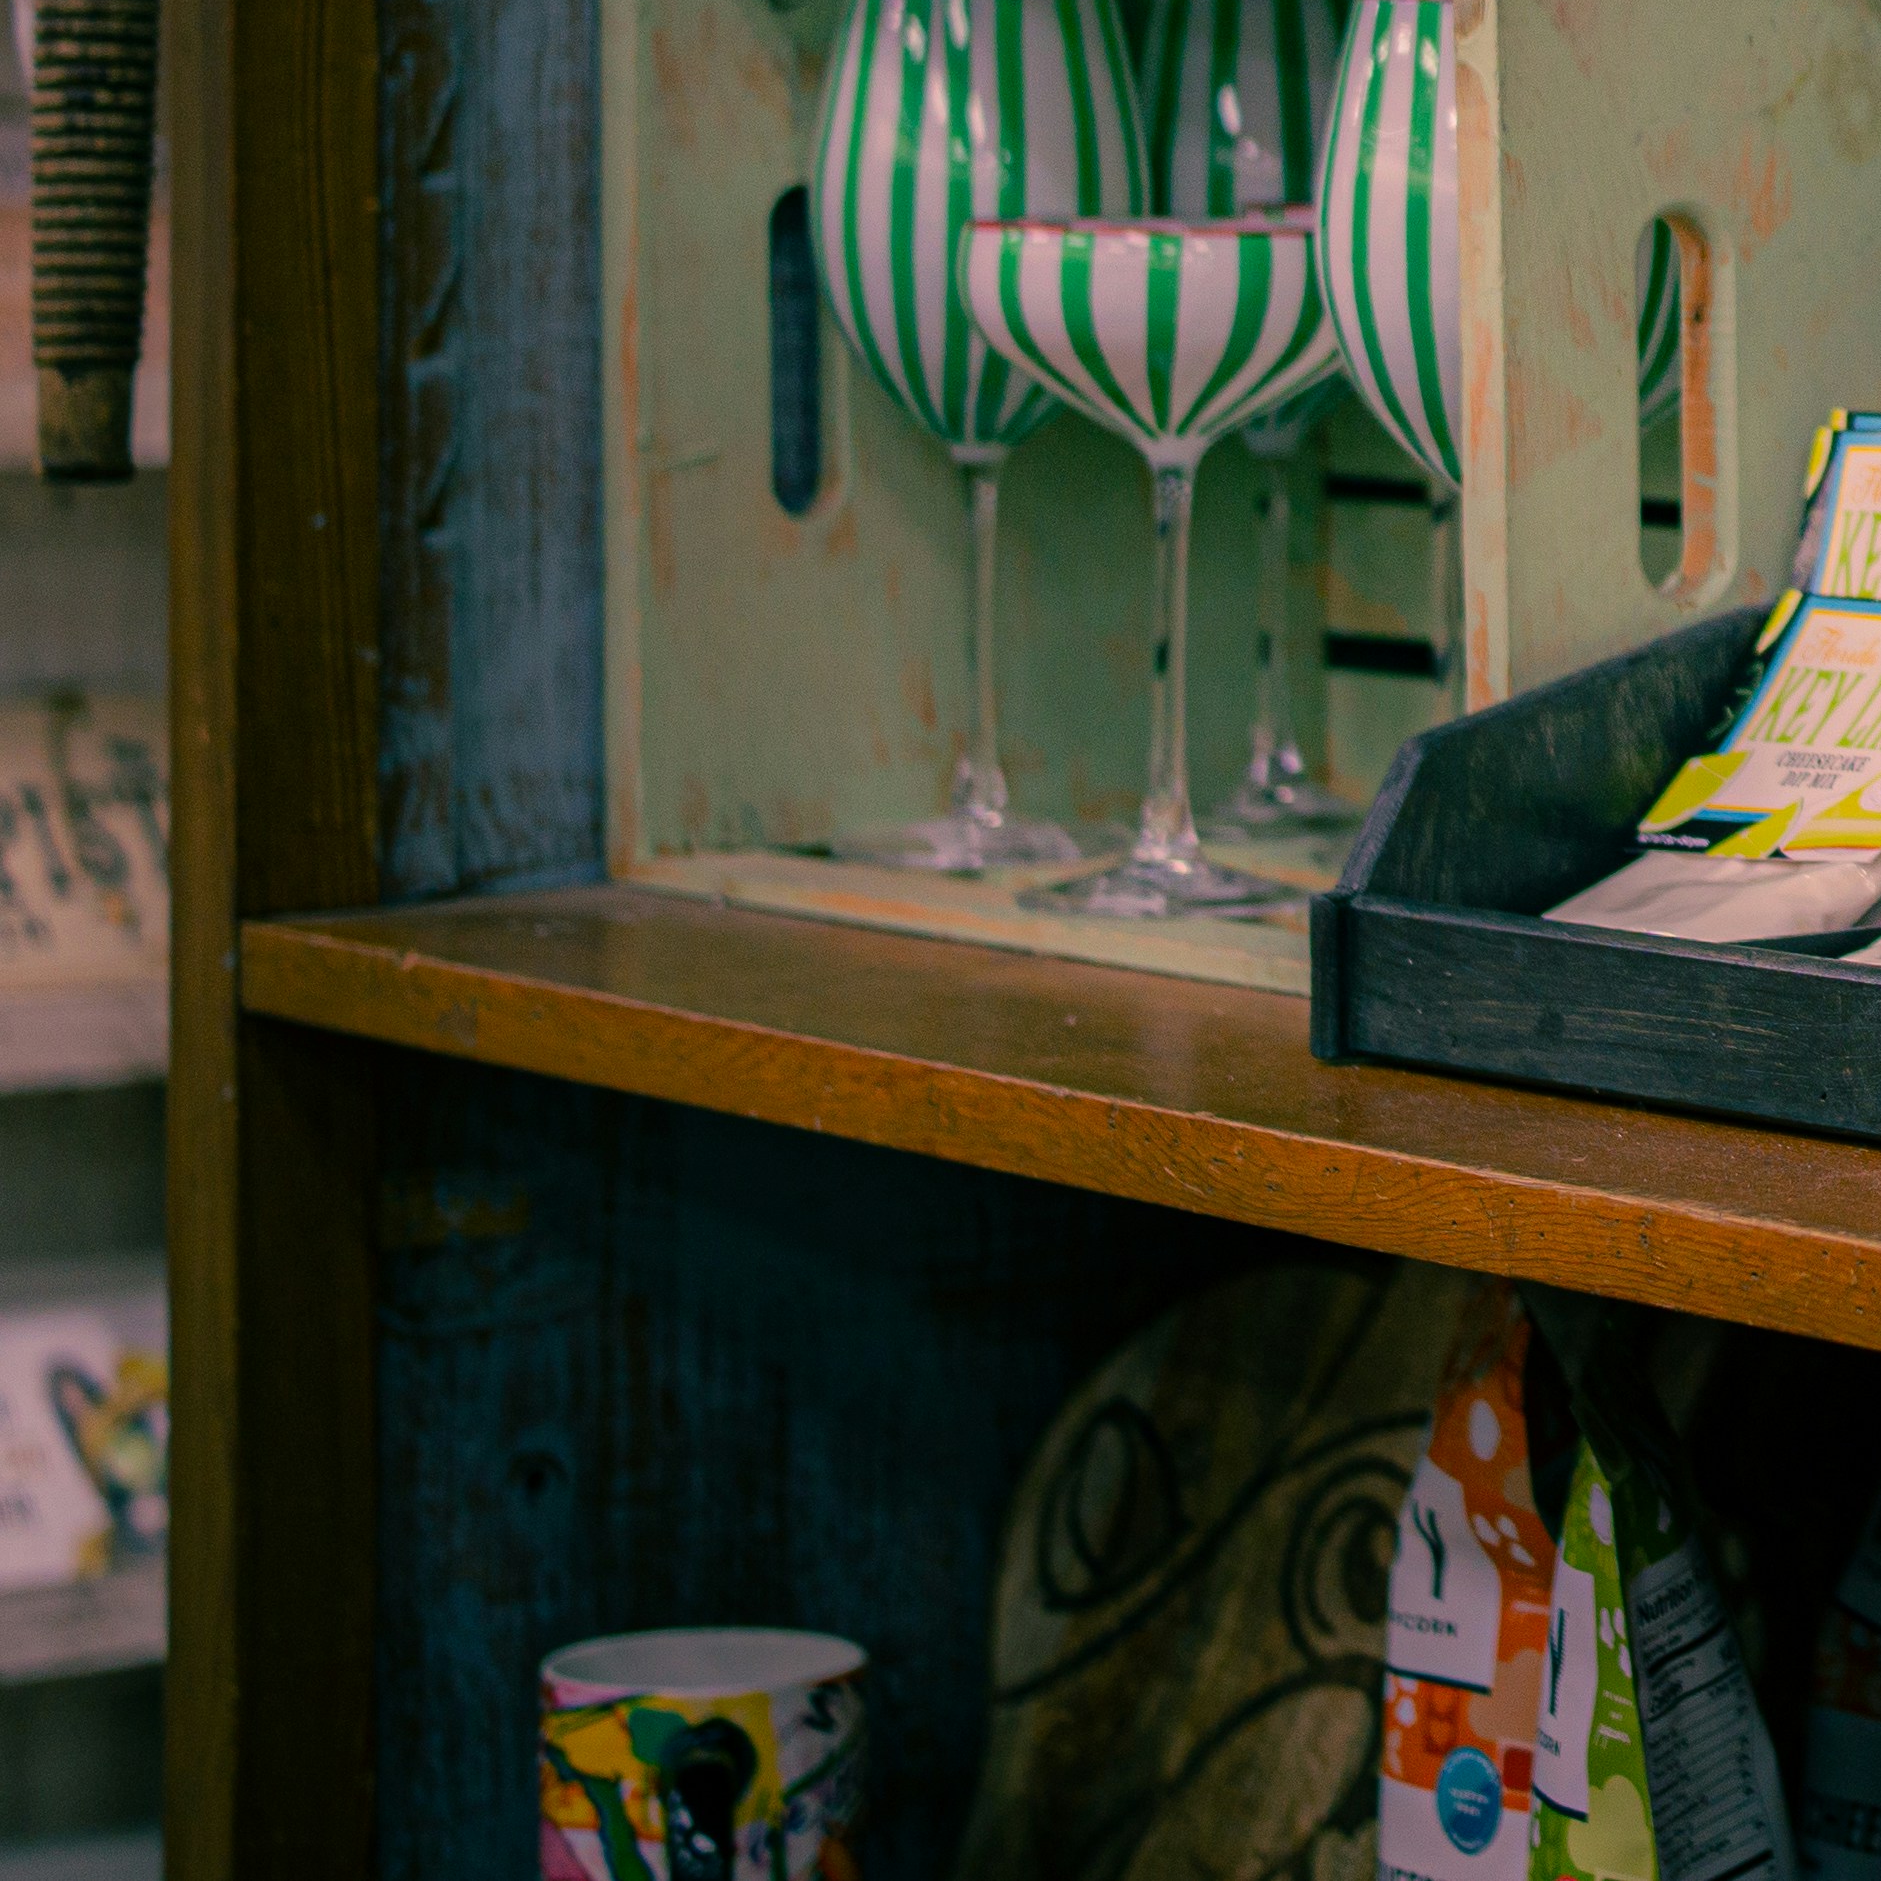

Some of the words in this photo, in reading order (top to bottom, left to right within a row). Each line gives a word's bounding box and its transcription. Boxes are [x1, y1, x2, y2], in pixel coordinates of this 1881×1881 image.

[1748, 665, 1869, 746] KEY
[1775, 750, 1872, 774] CHEESECAKE
[1778, 772, 1811, 788] DIP
[1811, 772, 1842, 791] MIX
